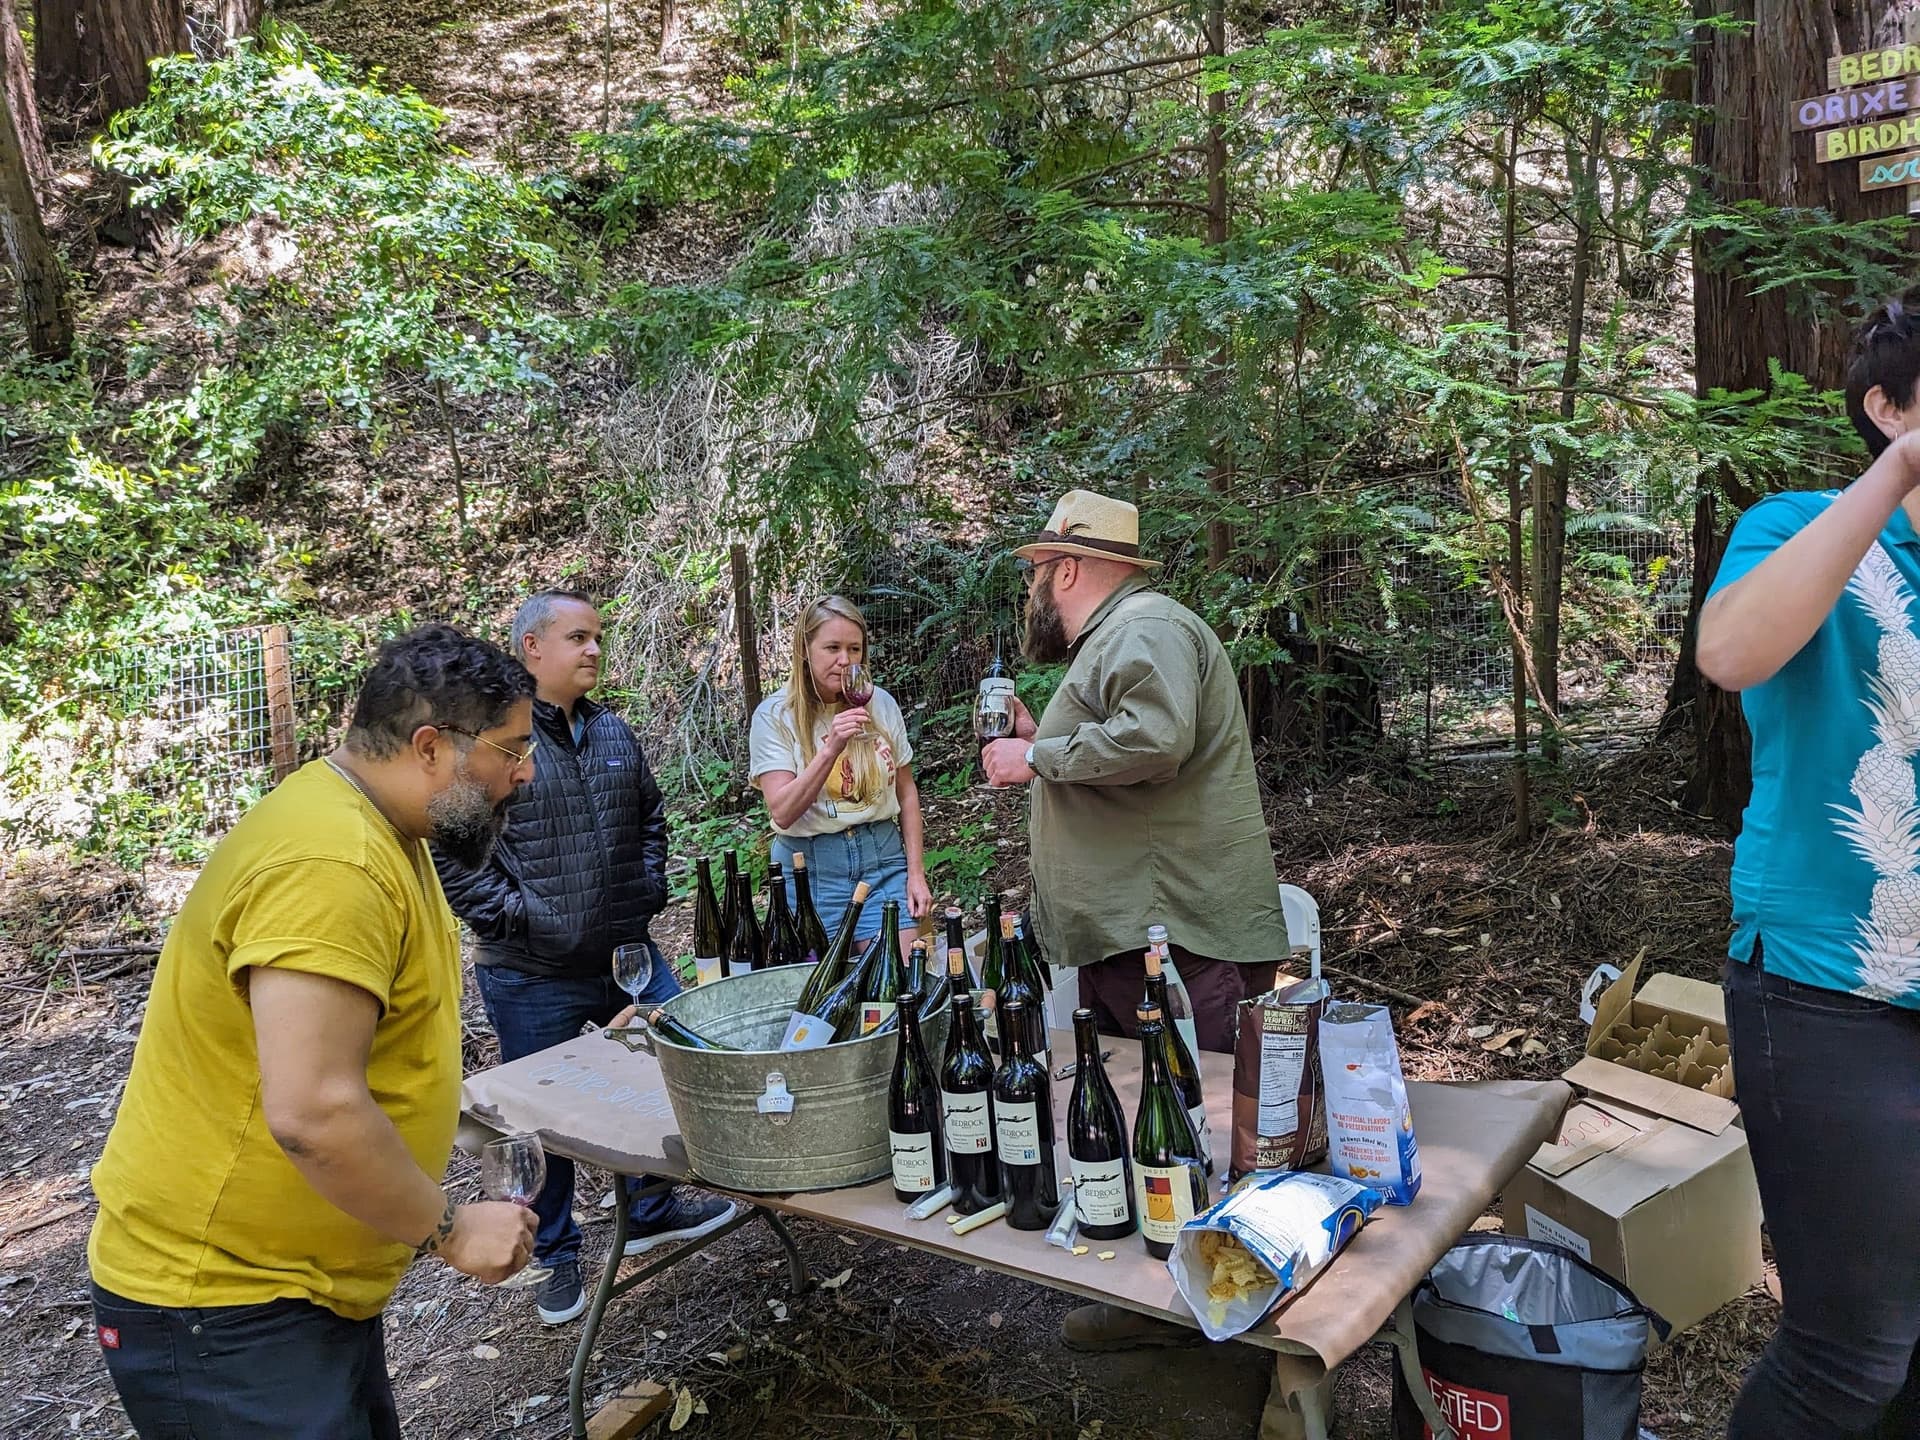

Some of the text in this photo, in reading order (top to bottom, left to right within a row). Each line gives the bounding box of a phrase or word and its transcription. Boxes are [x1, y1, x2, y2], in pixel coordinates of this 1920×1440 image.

[1799, 84, 1908, 125] ORIXE
[1827, 117, 1920, 160] BIRDH
[952, 1119, 984, 1127] BEDROCK
[1000, 1128, 1032, 1137] BEDROCK
[896, 1158, 928, 1166] BEDROCK
[1085, 1187, 1121, 1197] BEDROCK
[1555, 1231, 1566, 1242] THE
[1429, 1376, 1502, 1432] FATTED
